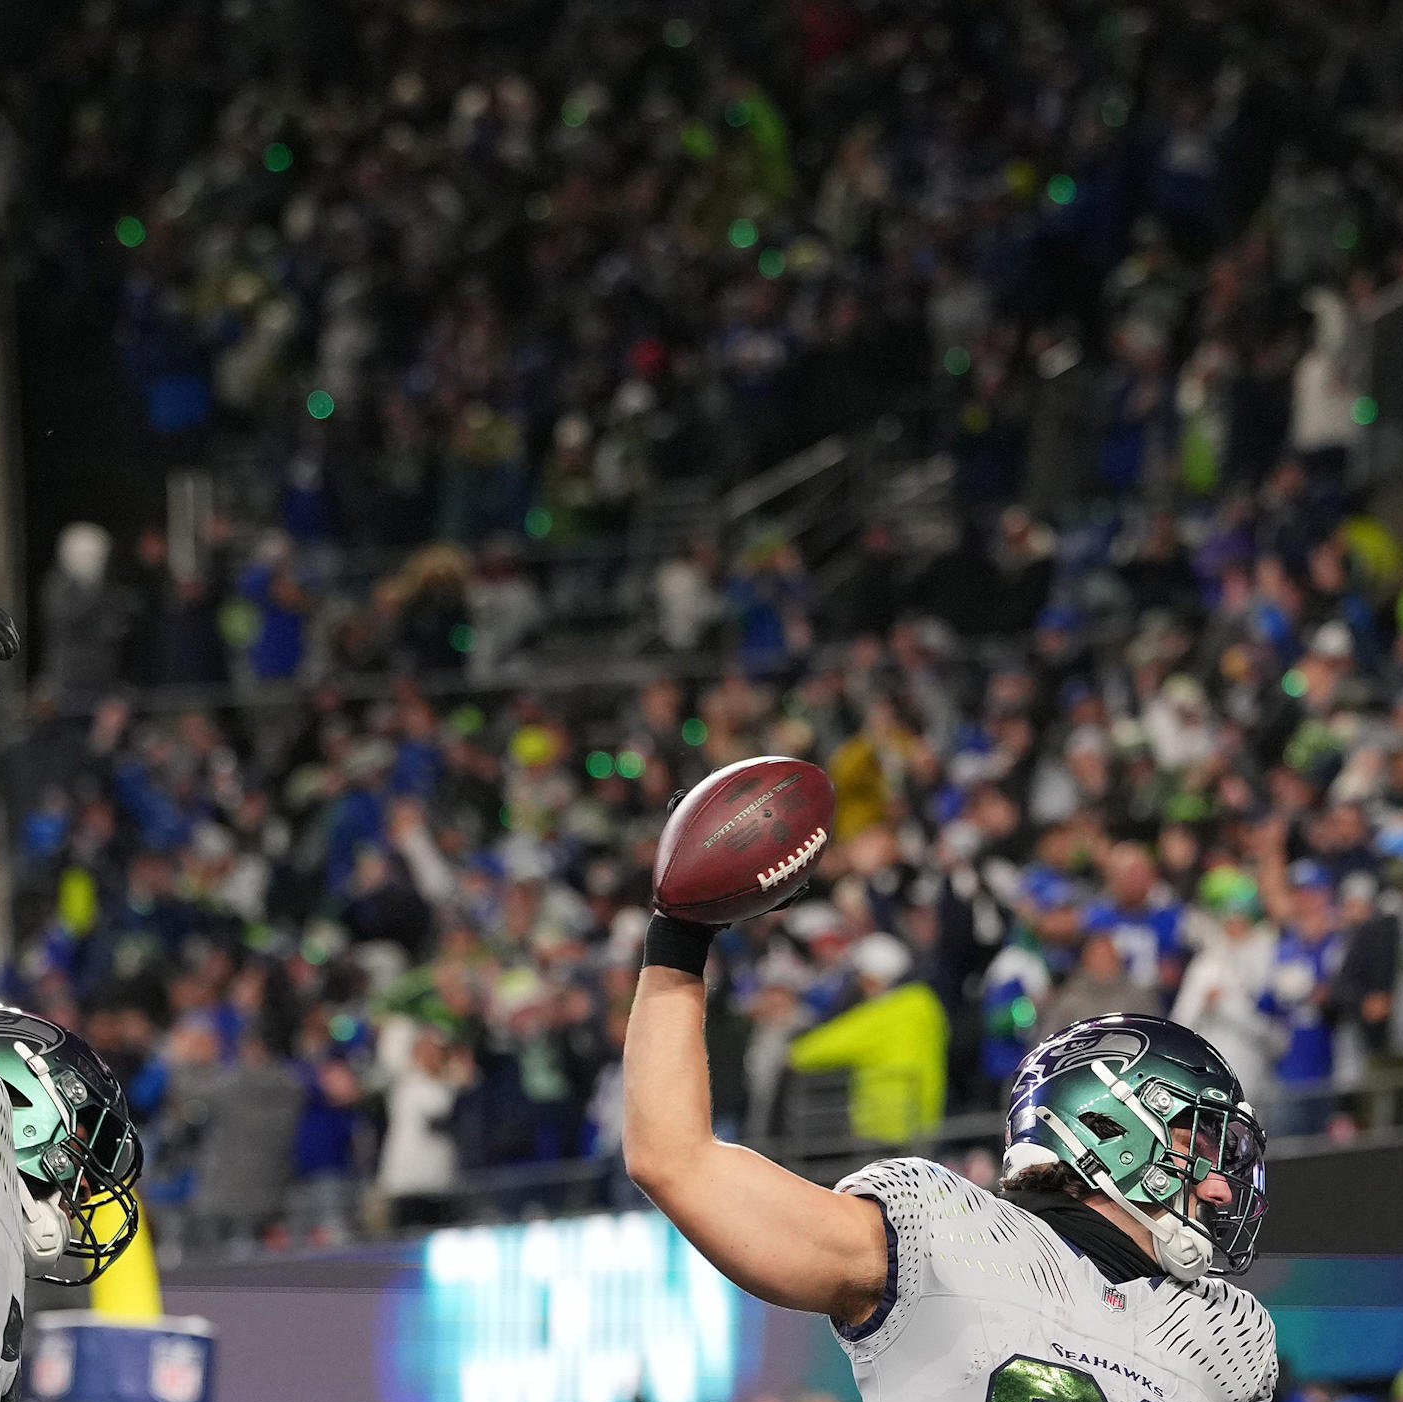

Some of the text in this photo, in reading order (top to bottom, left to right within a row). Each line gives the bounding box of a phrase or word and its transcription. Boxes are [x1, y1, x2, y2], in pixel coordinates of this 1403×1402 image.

[734, 789, 775, 822] FOOTBALL
[703, 820, 736, 850] LEAGUE
[1051, 1342, 1165, 1399] SEAHAWKS
